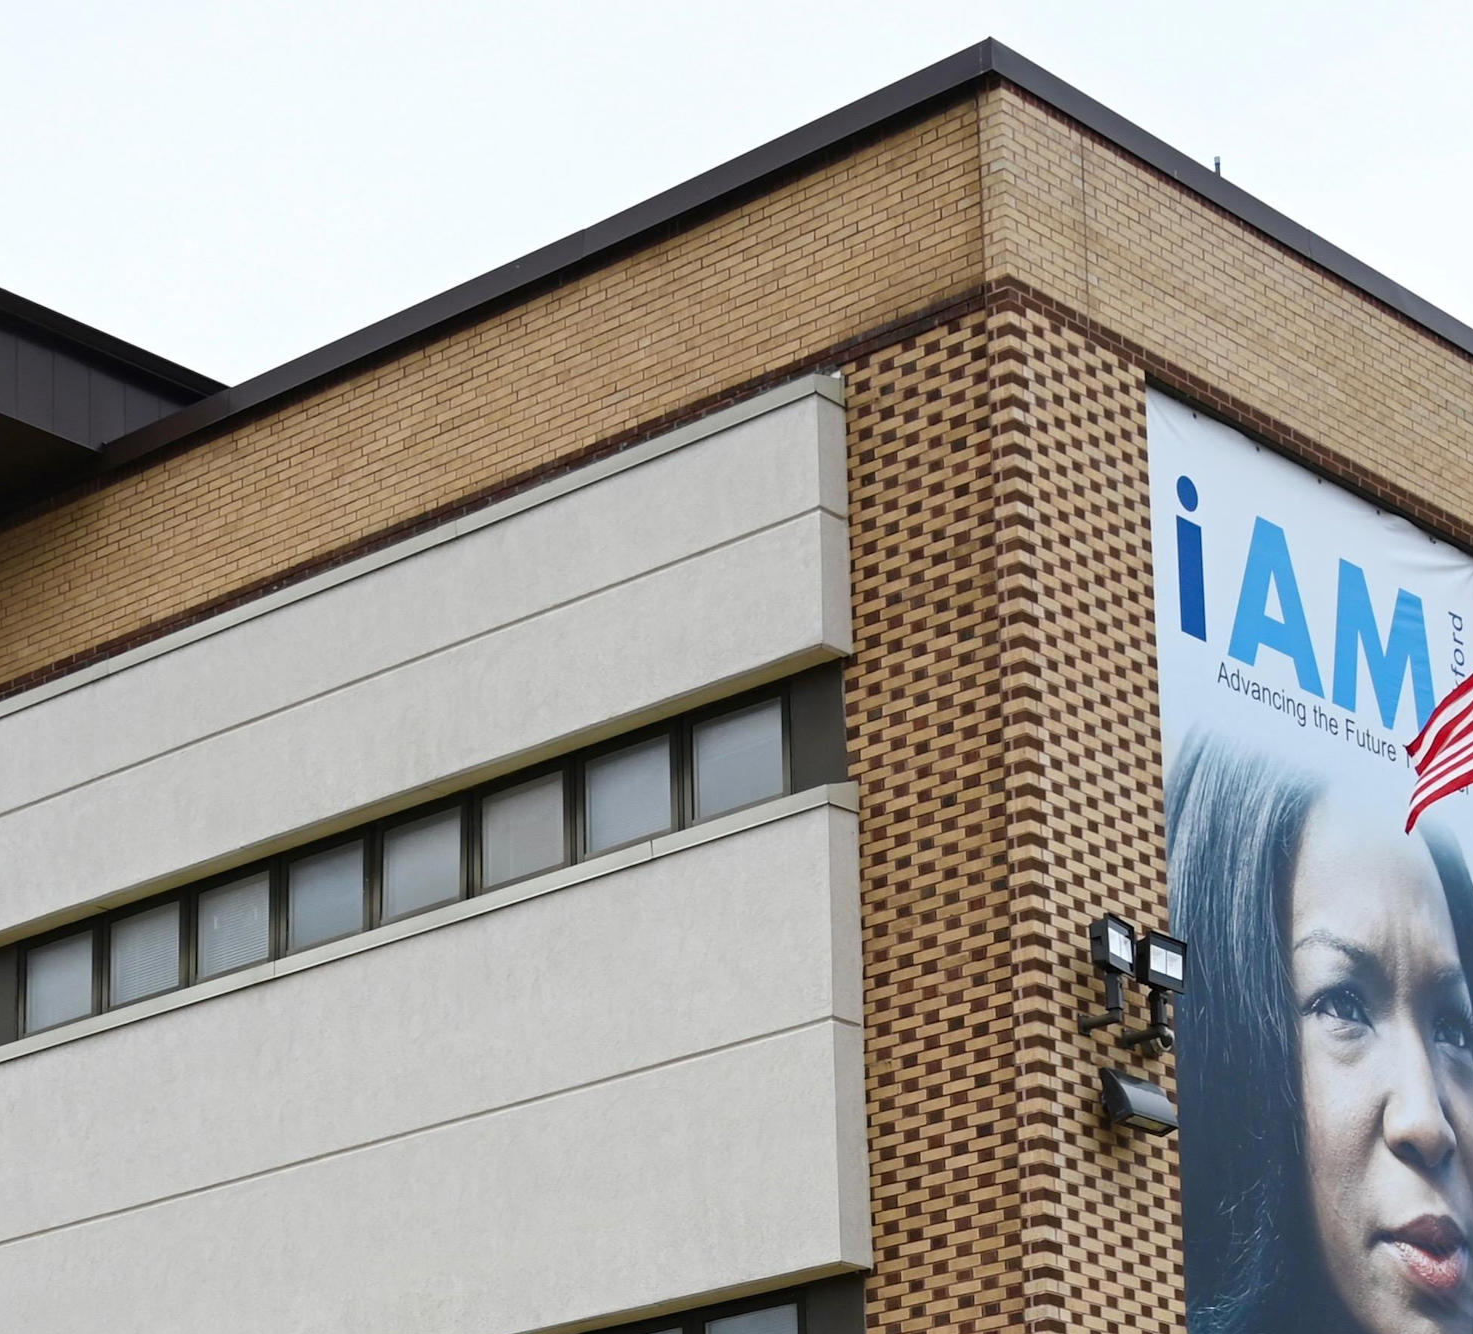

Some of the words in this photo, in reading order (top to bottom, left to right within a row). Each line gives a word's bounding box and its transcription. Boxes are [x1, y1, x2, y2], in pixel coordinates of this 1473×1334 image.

[1217, 662, 1307, 727] Advancing
[1313, 706, 1339, 735] the
[1346, 719, 1397, 762] Future
